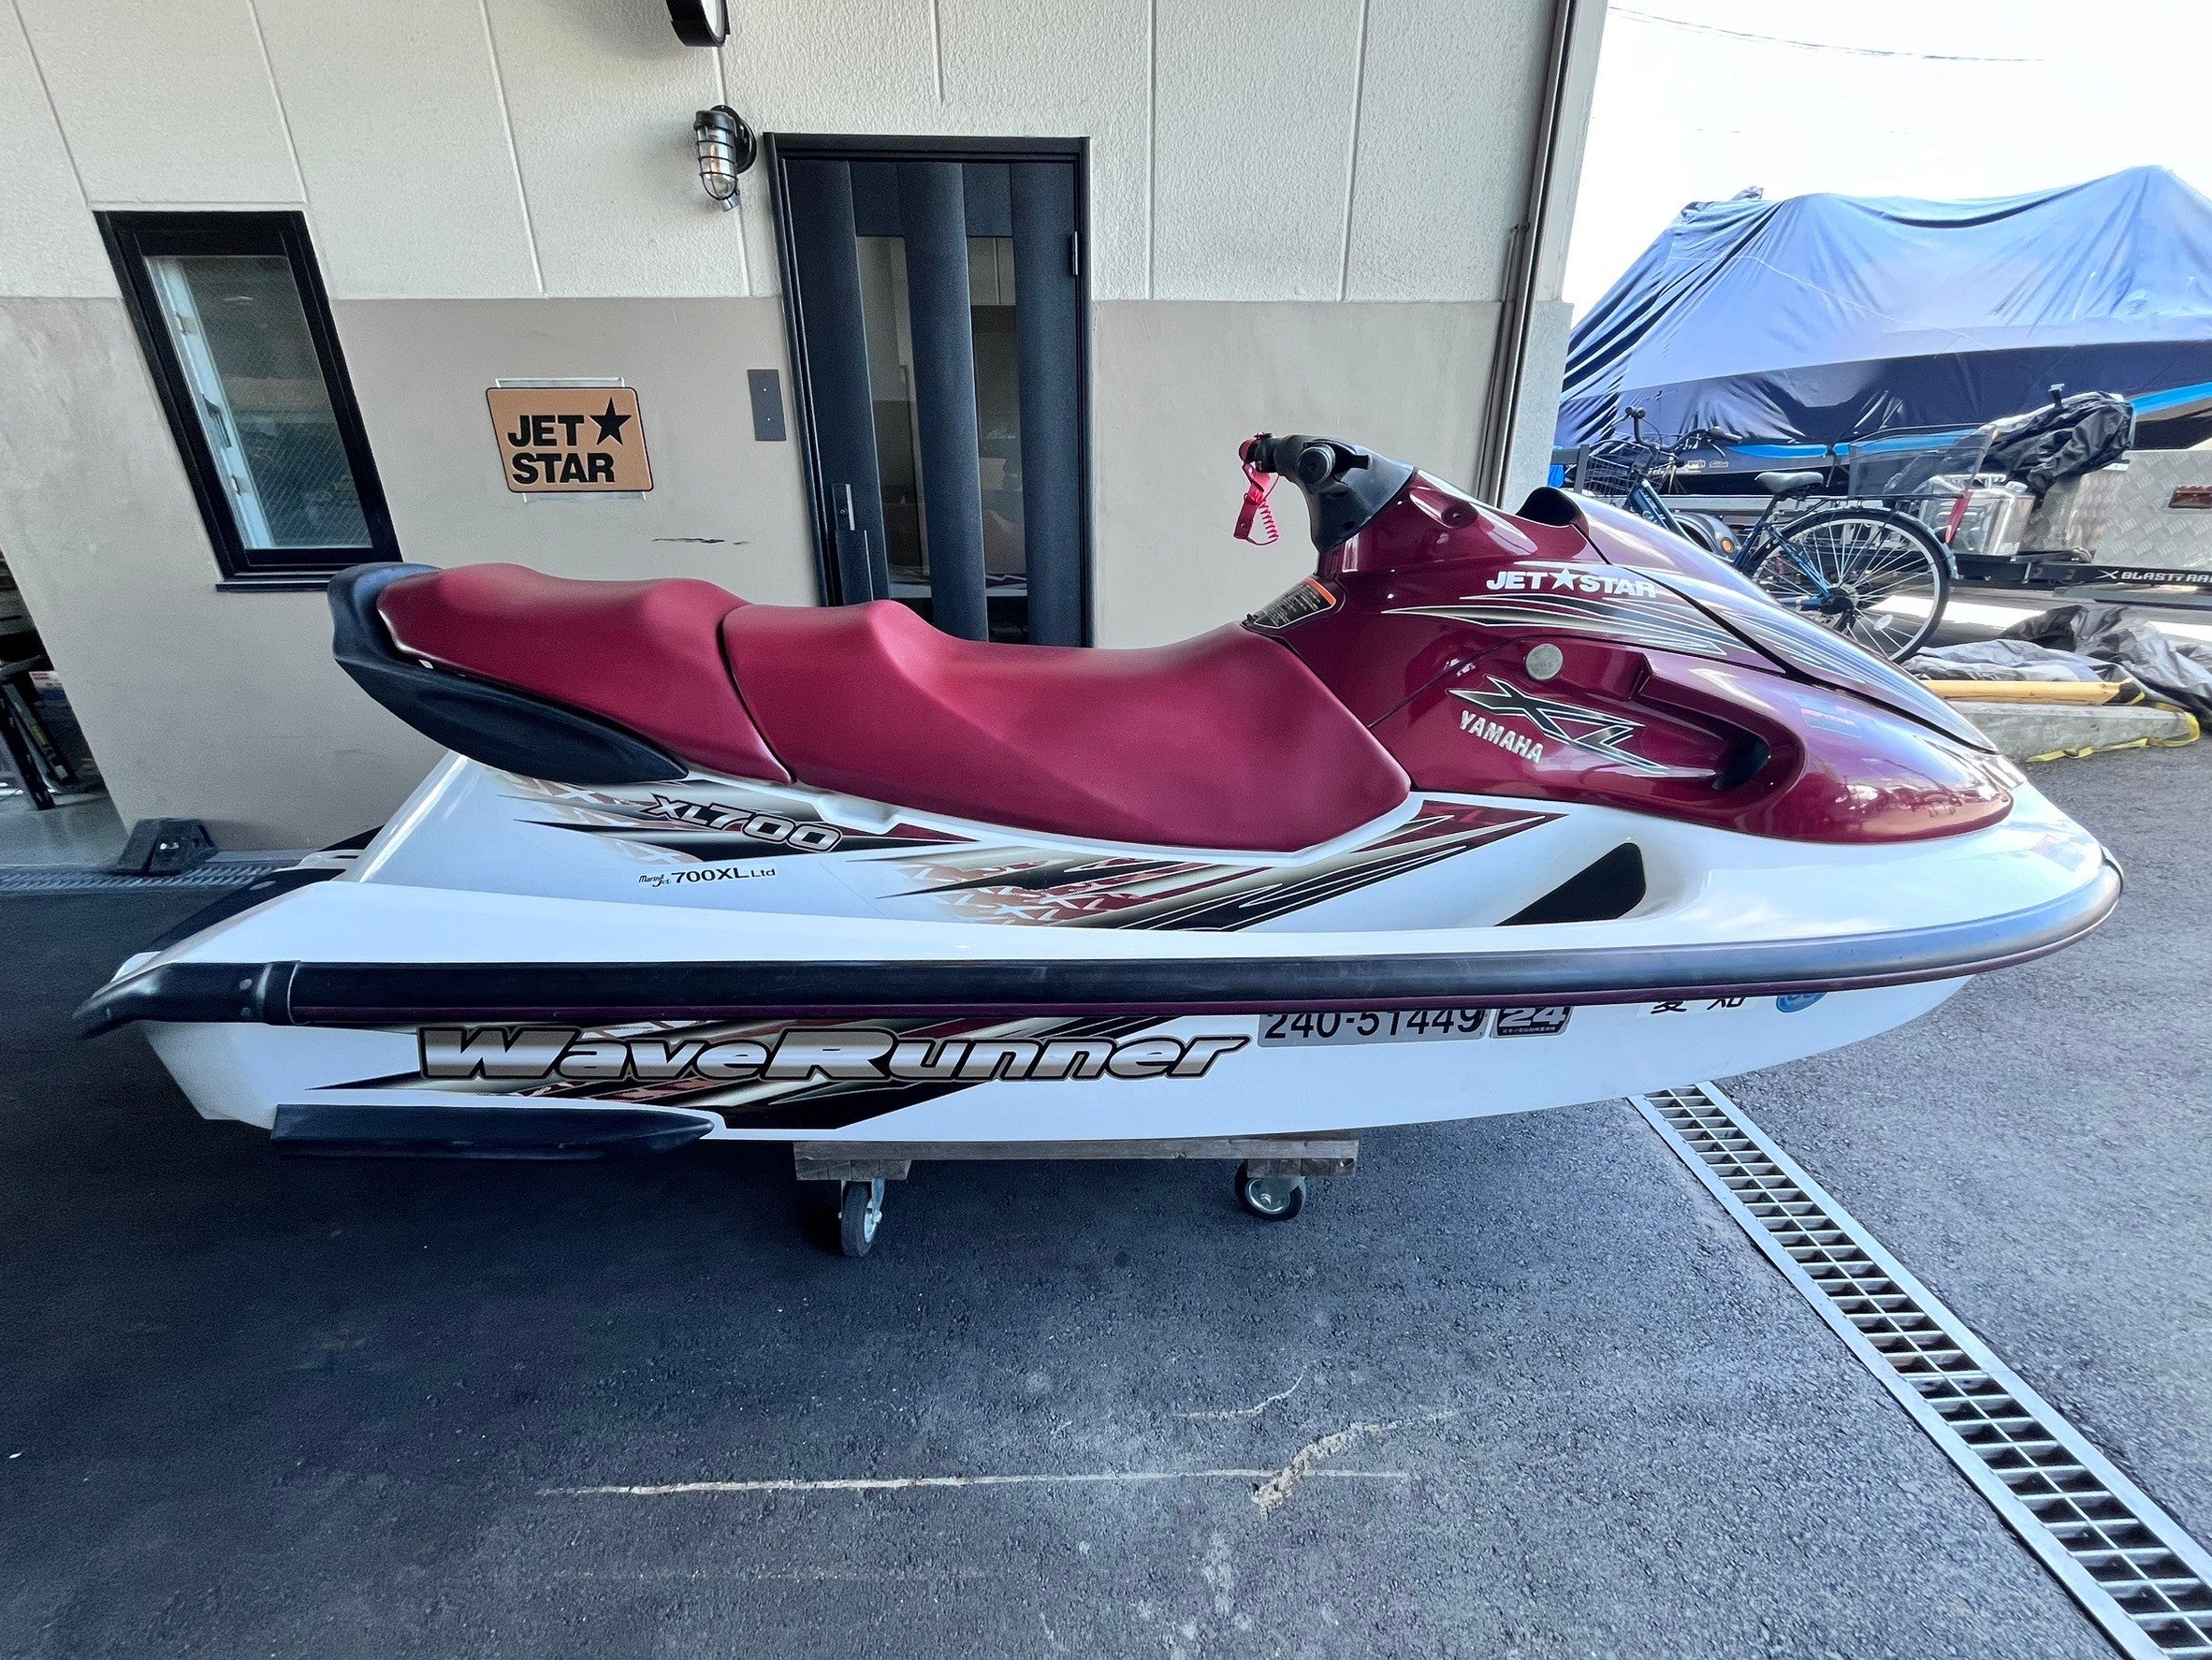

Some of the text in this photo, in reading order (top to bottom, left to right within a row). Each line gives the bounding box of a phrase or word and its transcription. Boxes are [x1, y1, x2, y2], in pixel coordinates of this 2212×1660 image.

[507, 415, 585, 447] JET
[512, 452, 616, 485] STAR
[1486, 571, 1656, 598] JET STAR
[1458, 709, 1545, 764] YAMAHA
[671, 866, 776, 883] 700XL Ltd
[1264, 1009, 1486, 1040] 240-51449
[1498, 1007, 1566, 1027] 24
[420, 1027, 1251, 1081] WaveRunner
